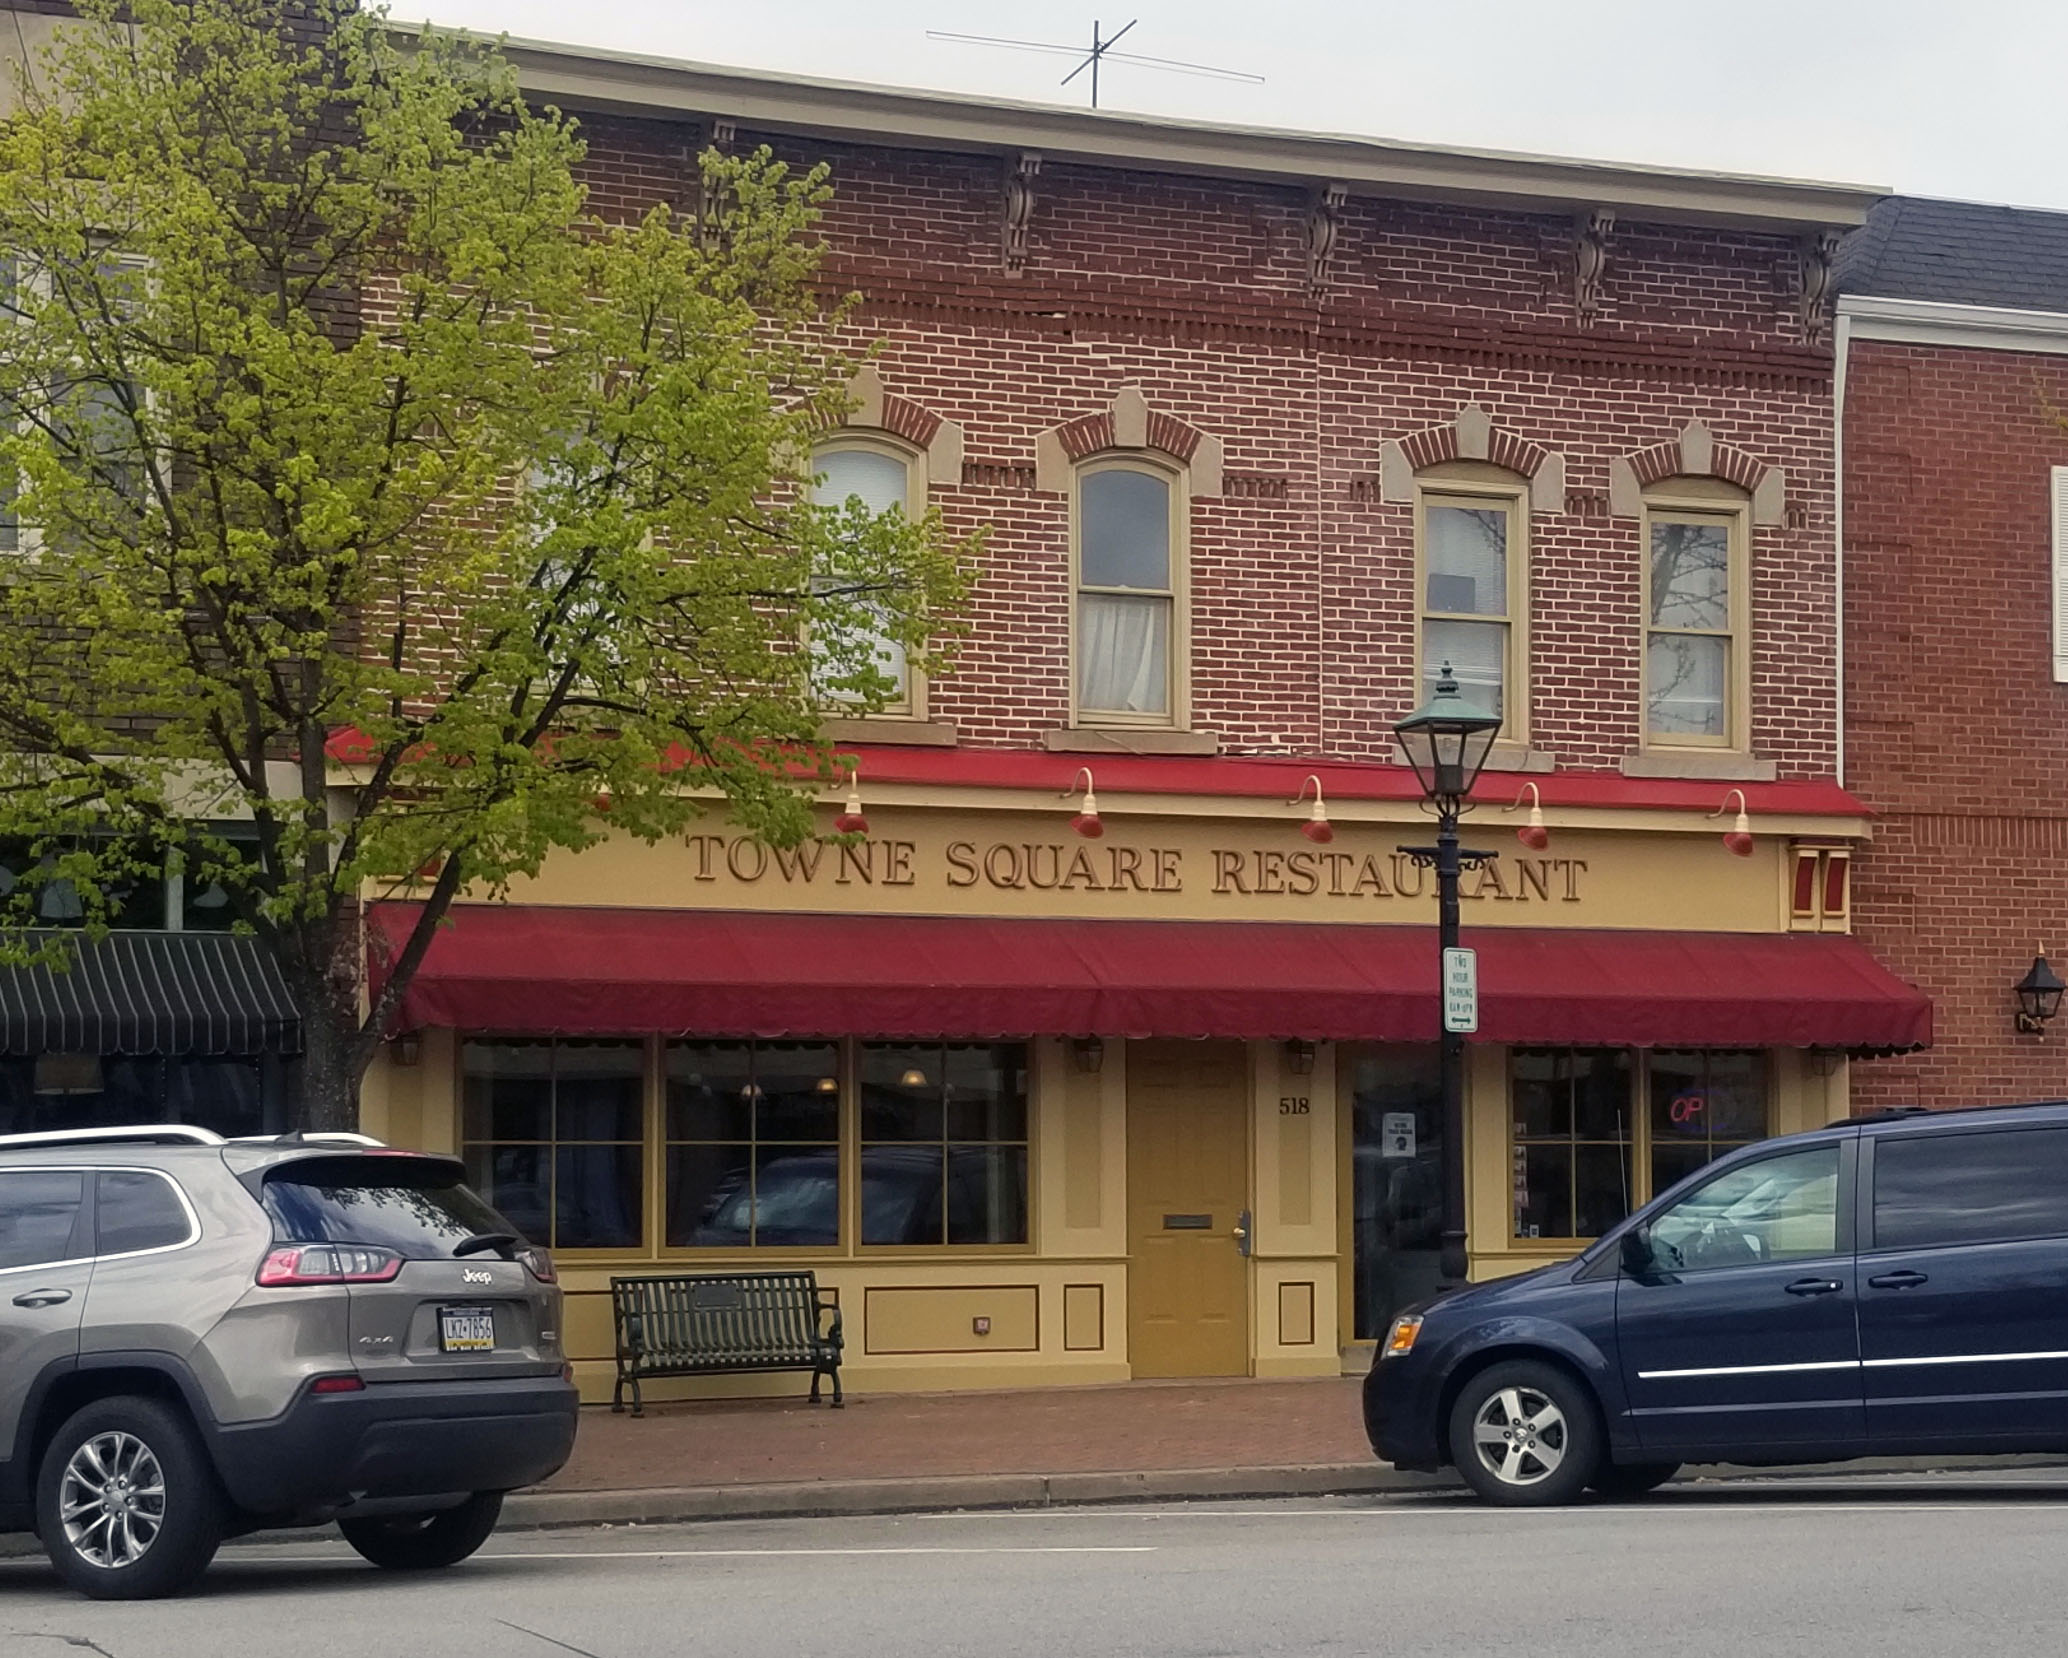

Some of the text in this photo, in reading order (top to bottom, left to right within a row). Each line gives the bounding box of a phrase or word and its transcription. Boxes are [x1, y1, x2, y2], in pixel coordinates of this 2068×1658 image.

[685, 834, 916, 885] TOWNE
[946, 840, 1183, 892] SQUARE
[1279, 1097, 1310, 1115] 518
[462, 1268, 492, 1285] Jeep
